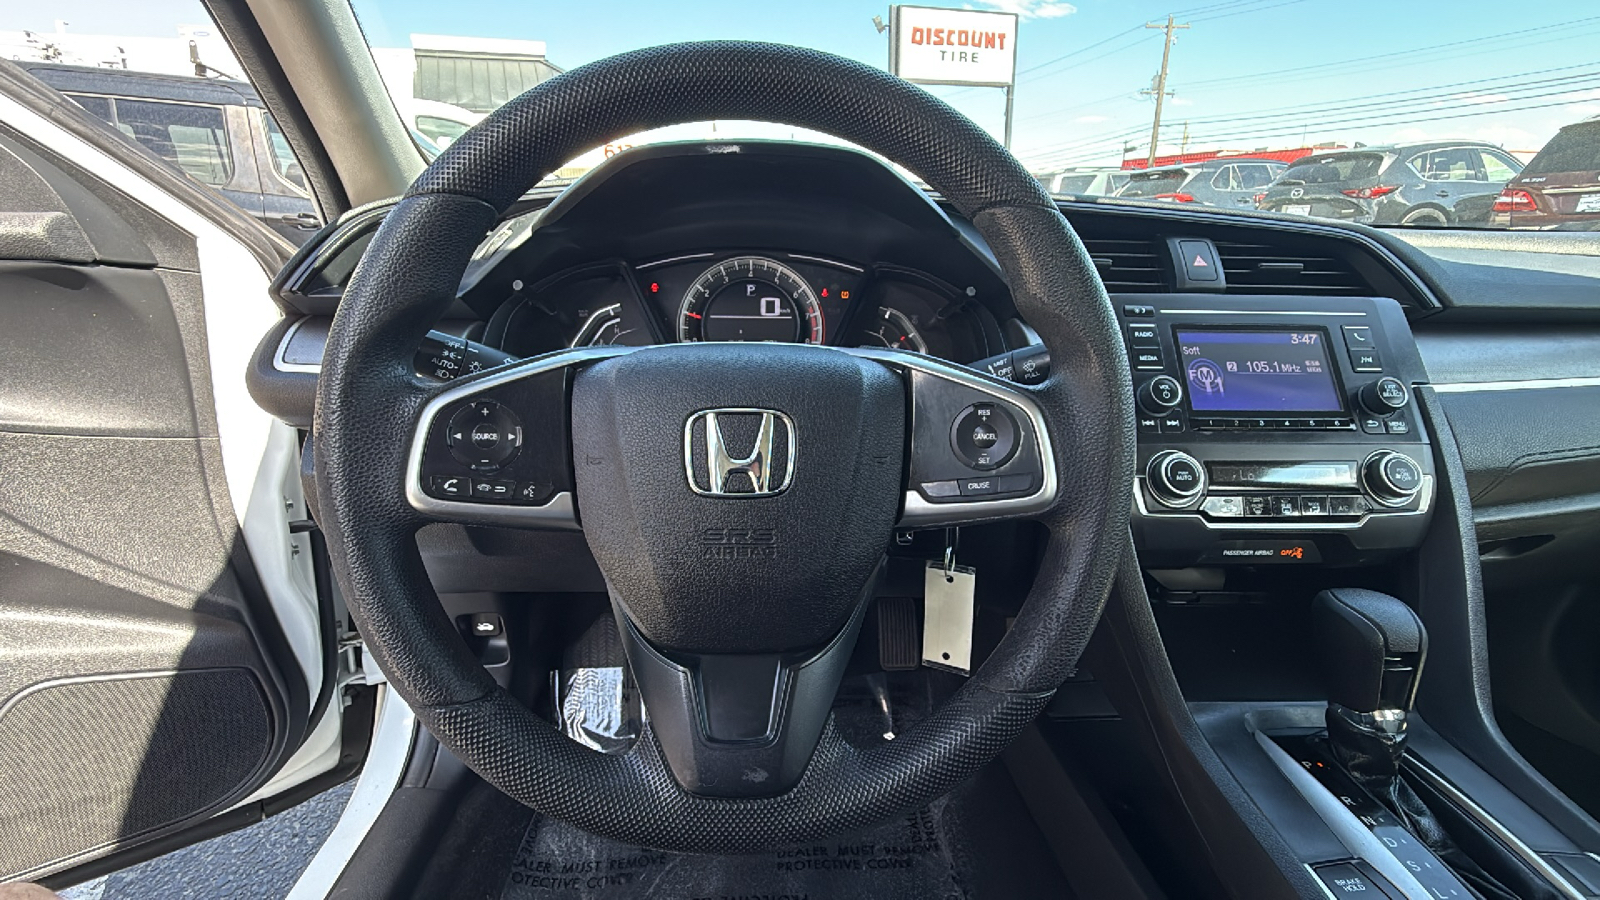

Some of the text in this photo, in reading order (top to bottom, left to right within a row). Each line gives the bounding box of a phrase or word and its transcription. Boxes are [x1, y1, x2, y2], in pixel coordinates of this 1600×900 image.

[911, 26, 1006, 50] DISCOUNT
[940, 50, 979, 63] TIRE
[704, 290, 710, 298] 2
[746, 284, 756, 296] P
[793, 290, 798, 298] 6
[760, 297, 780, 316] 0
[445, 340, 460, 348] OFF
[1291, 334, 1317, 344] 3:47
[1182, 346, 1200, 355] Soft
[432, 358, 454, 369] AUTO
[1228, 361, 1301, 373] 2 105.1 MHz
[998, 367, 1012, 376] OFF
[968, 481, 990, 490] CRUISE
[702, 528, 776, 544] SRS
[1340, 796, 1356, 806] R
[1360, 816, 1377, 826] N
[1383, 837, 1398, 848] D
[777, 846, 830, 858] DEALER
[838, 844, 875, 856] MUST
[562, 860, 600, 874] MUST
[609, 854, 666, 870] REMOVE
[777, 859, 860, 871] PROTECTIVE
[1406, 860, 1421, 872] S
[1432, 887, 1448, 900] L
